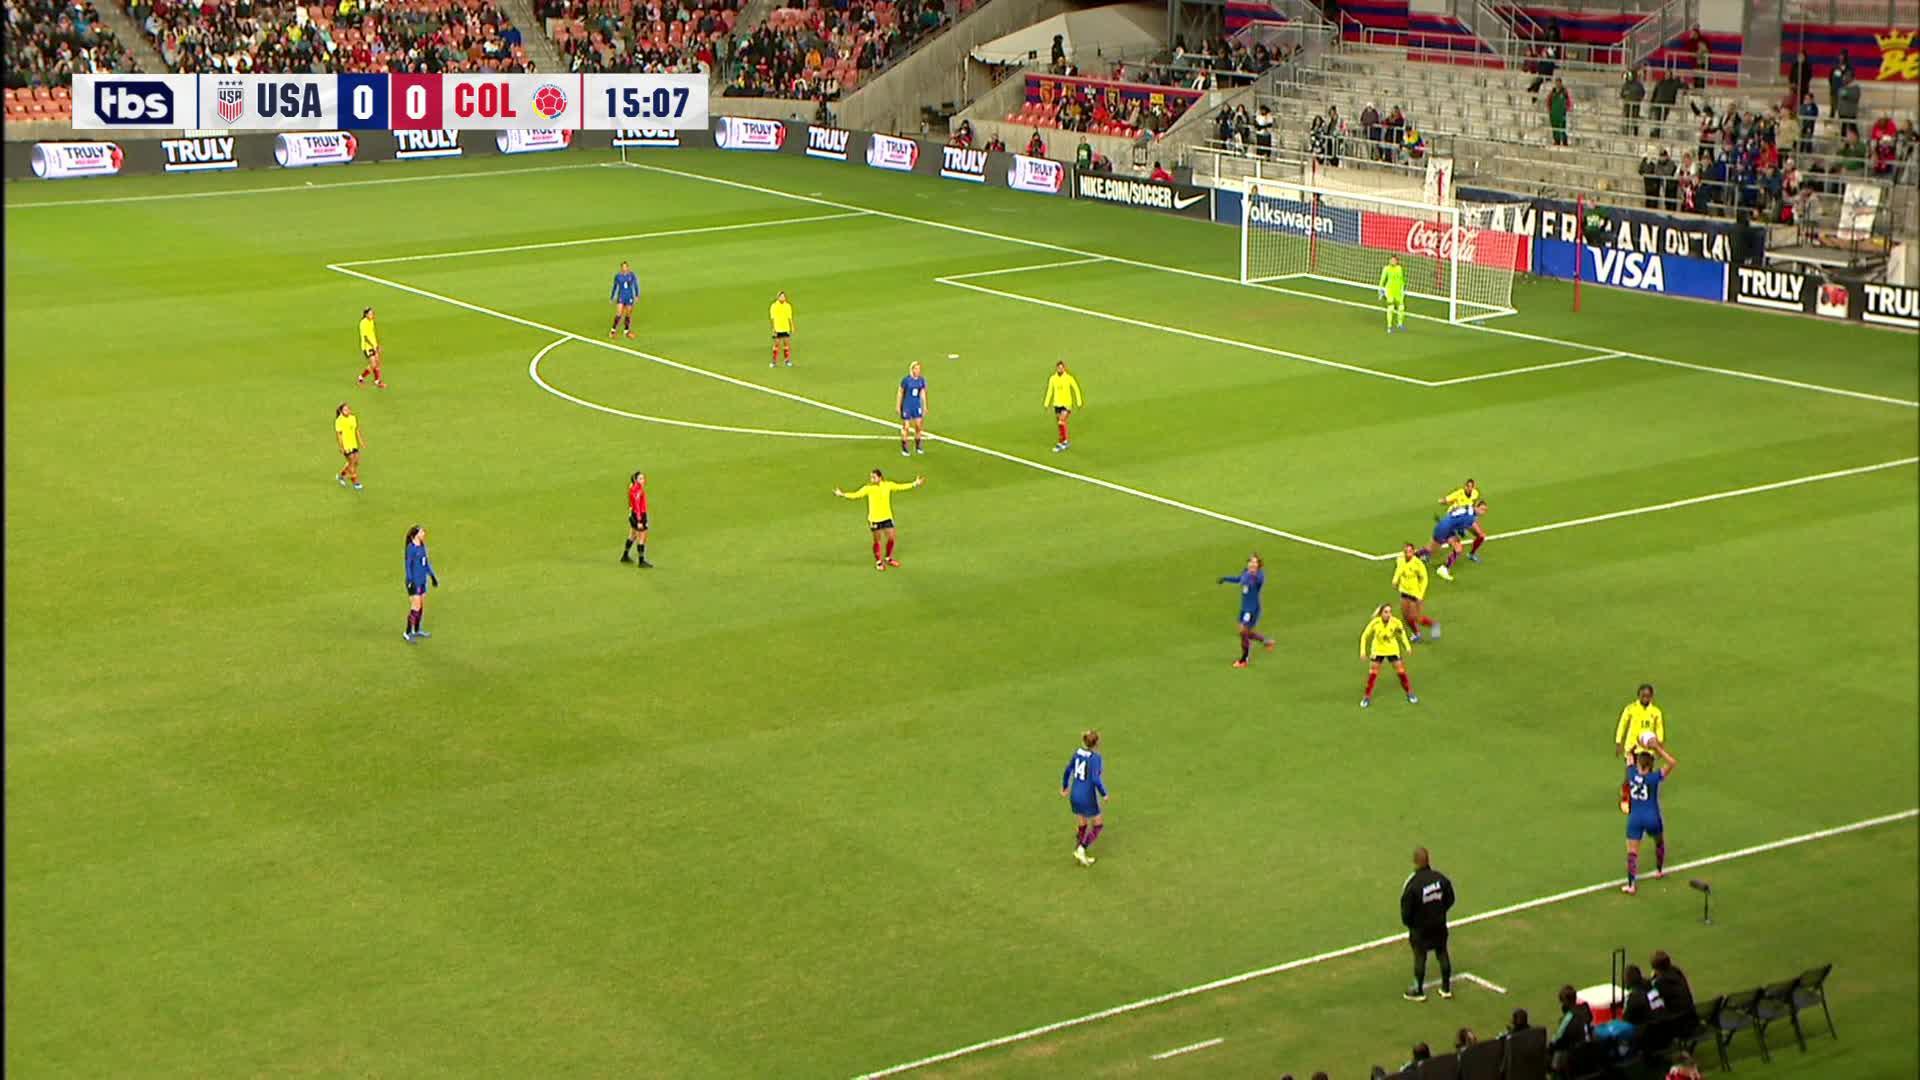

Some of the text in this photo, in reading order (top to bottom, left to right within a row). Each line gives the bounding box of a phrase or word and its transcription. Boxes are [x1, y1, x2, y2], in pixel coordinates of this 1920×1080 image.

[393, 129, 458, 150] TRULY
[743, 122, 771, 135] TRULY
[808, 126, 850, 153] TRULY
[63, 146, 104, 159] TRULY
[161, 137, 235, 162] TRULY
[303, 135, 340, 148] TRULY
[886, 140, 908, 155] TRULY
[944, 147, 988, 173] TRULY
[1029, 161, 1053, 177] TRULY
[1080, 175, 1172, 208] NIKE.COM/SOCCER
[1407, 219, 1480, 262] Coca-Cla
[1586, 245, 1666, 292] VISA
[1738, 268, 1804, 301] TRULY
[1074, 758, 1087, 781] 14
[1629, 781, 1648, 800] 23
